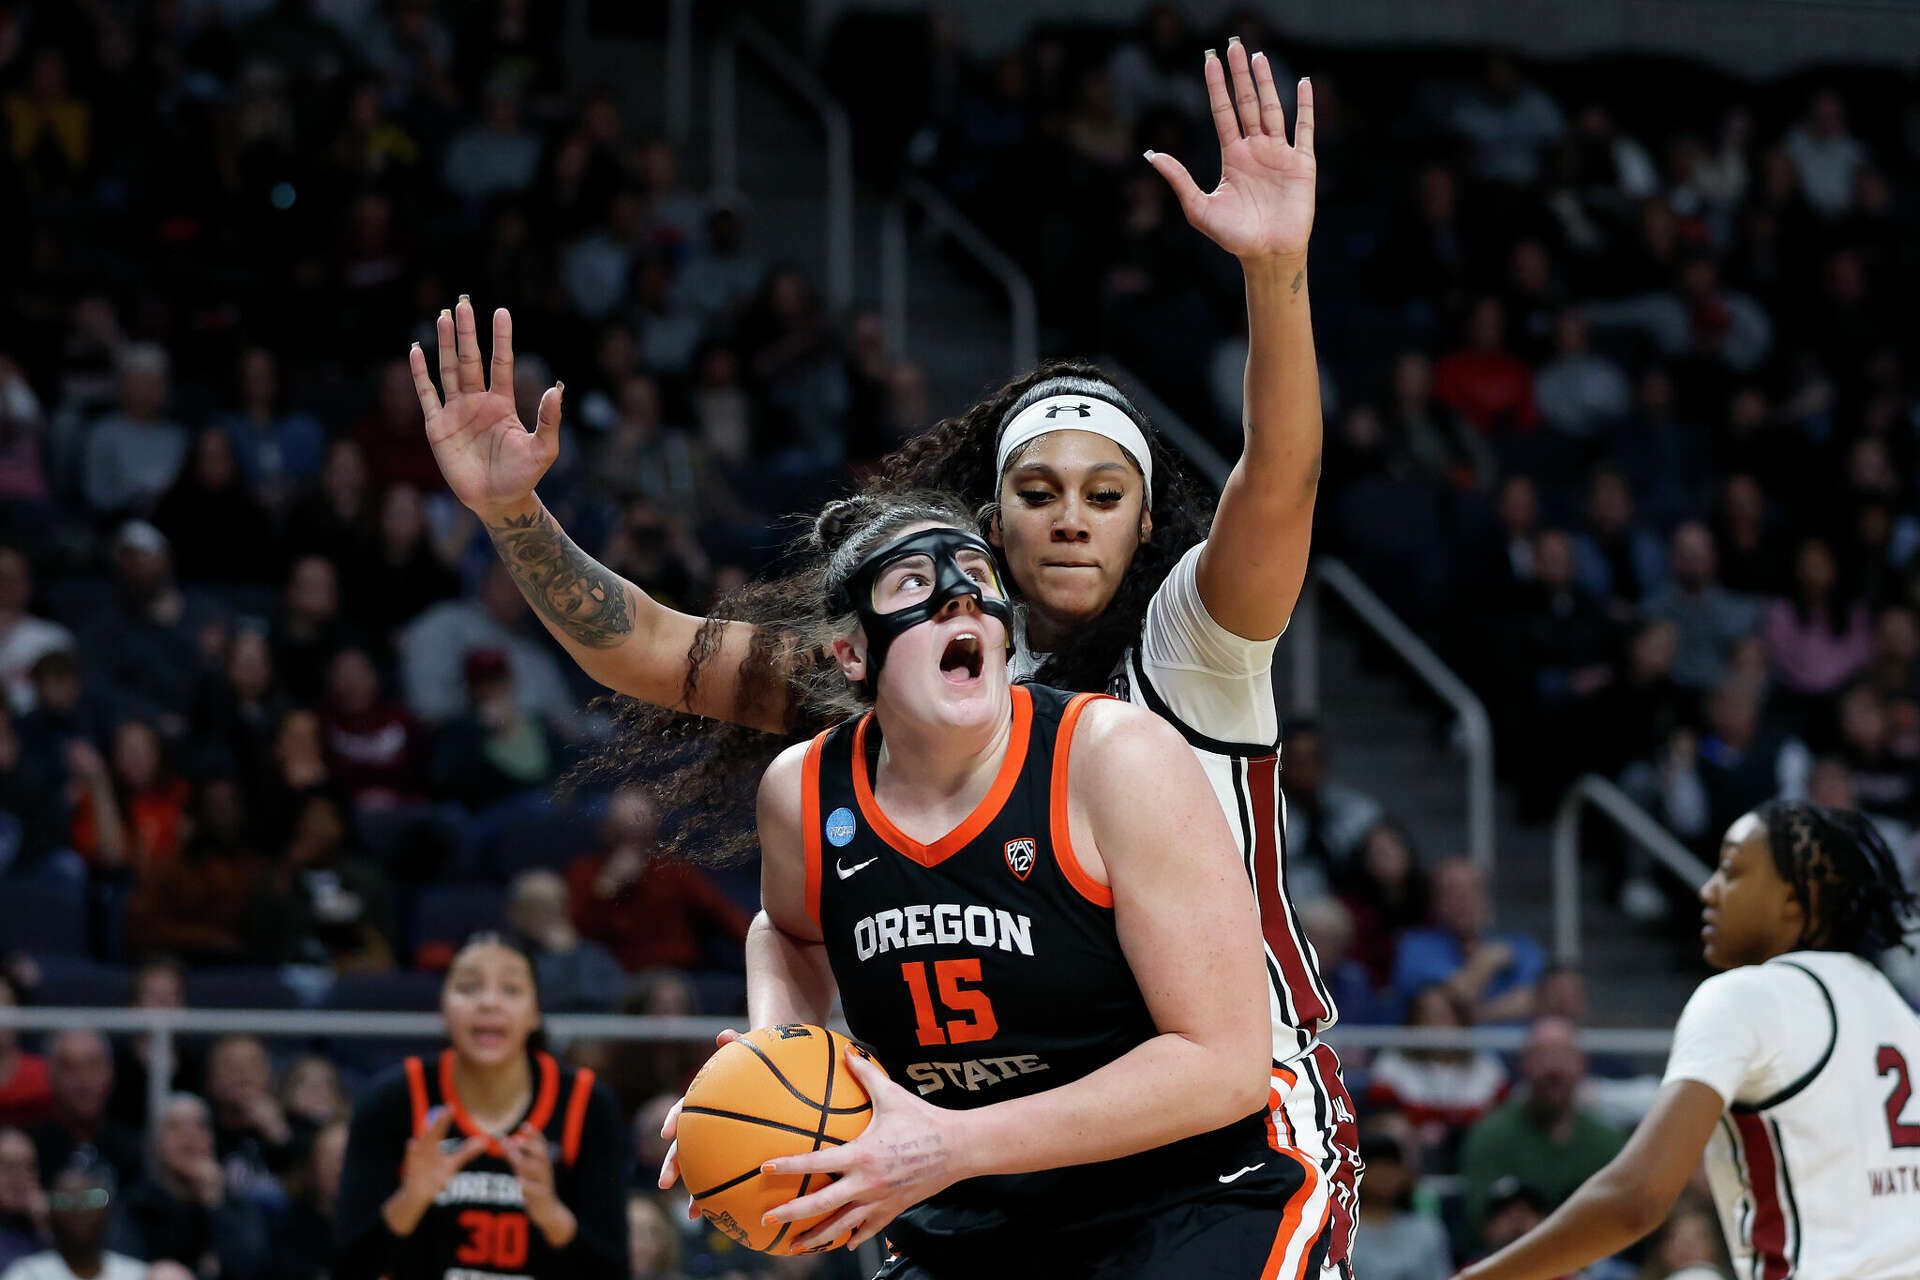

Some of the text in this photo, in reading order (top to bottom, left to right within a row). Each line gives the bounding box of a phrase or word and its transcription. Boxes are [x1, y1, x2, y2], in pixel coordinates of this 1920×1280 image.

[1007, 840, 1034, 865] PAC
[1015, 855, 1030, 871] 12
[854, 903, 1035, 962] OREGON
[901, 958, 999, 1047] 15
[906, 1054, 1051, 1096] STATE
[456, 1209, 529, 1269] 30
